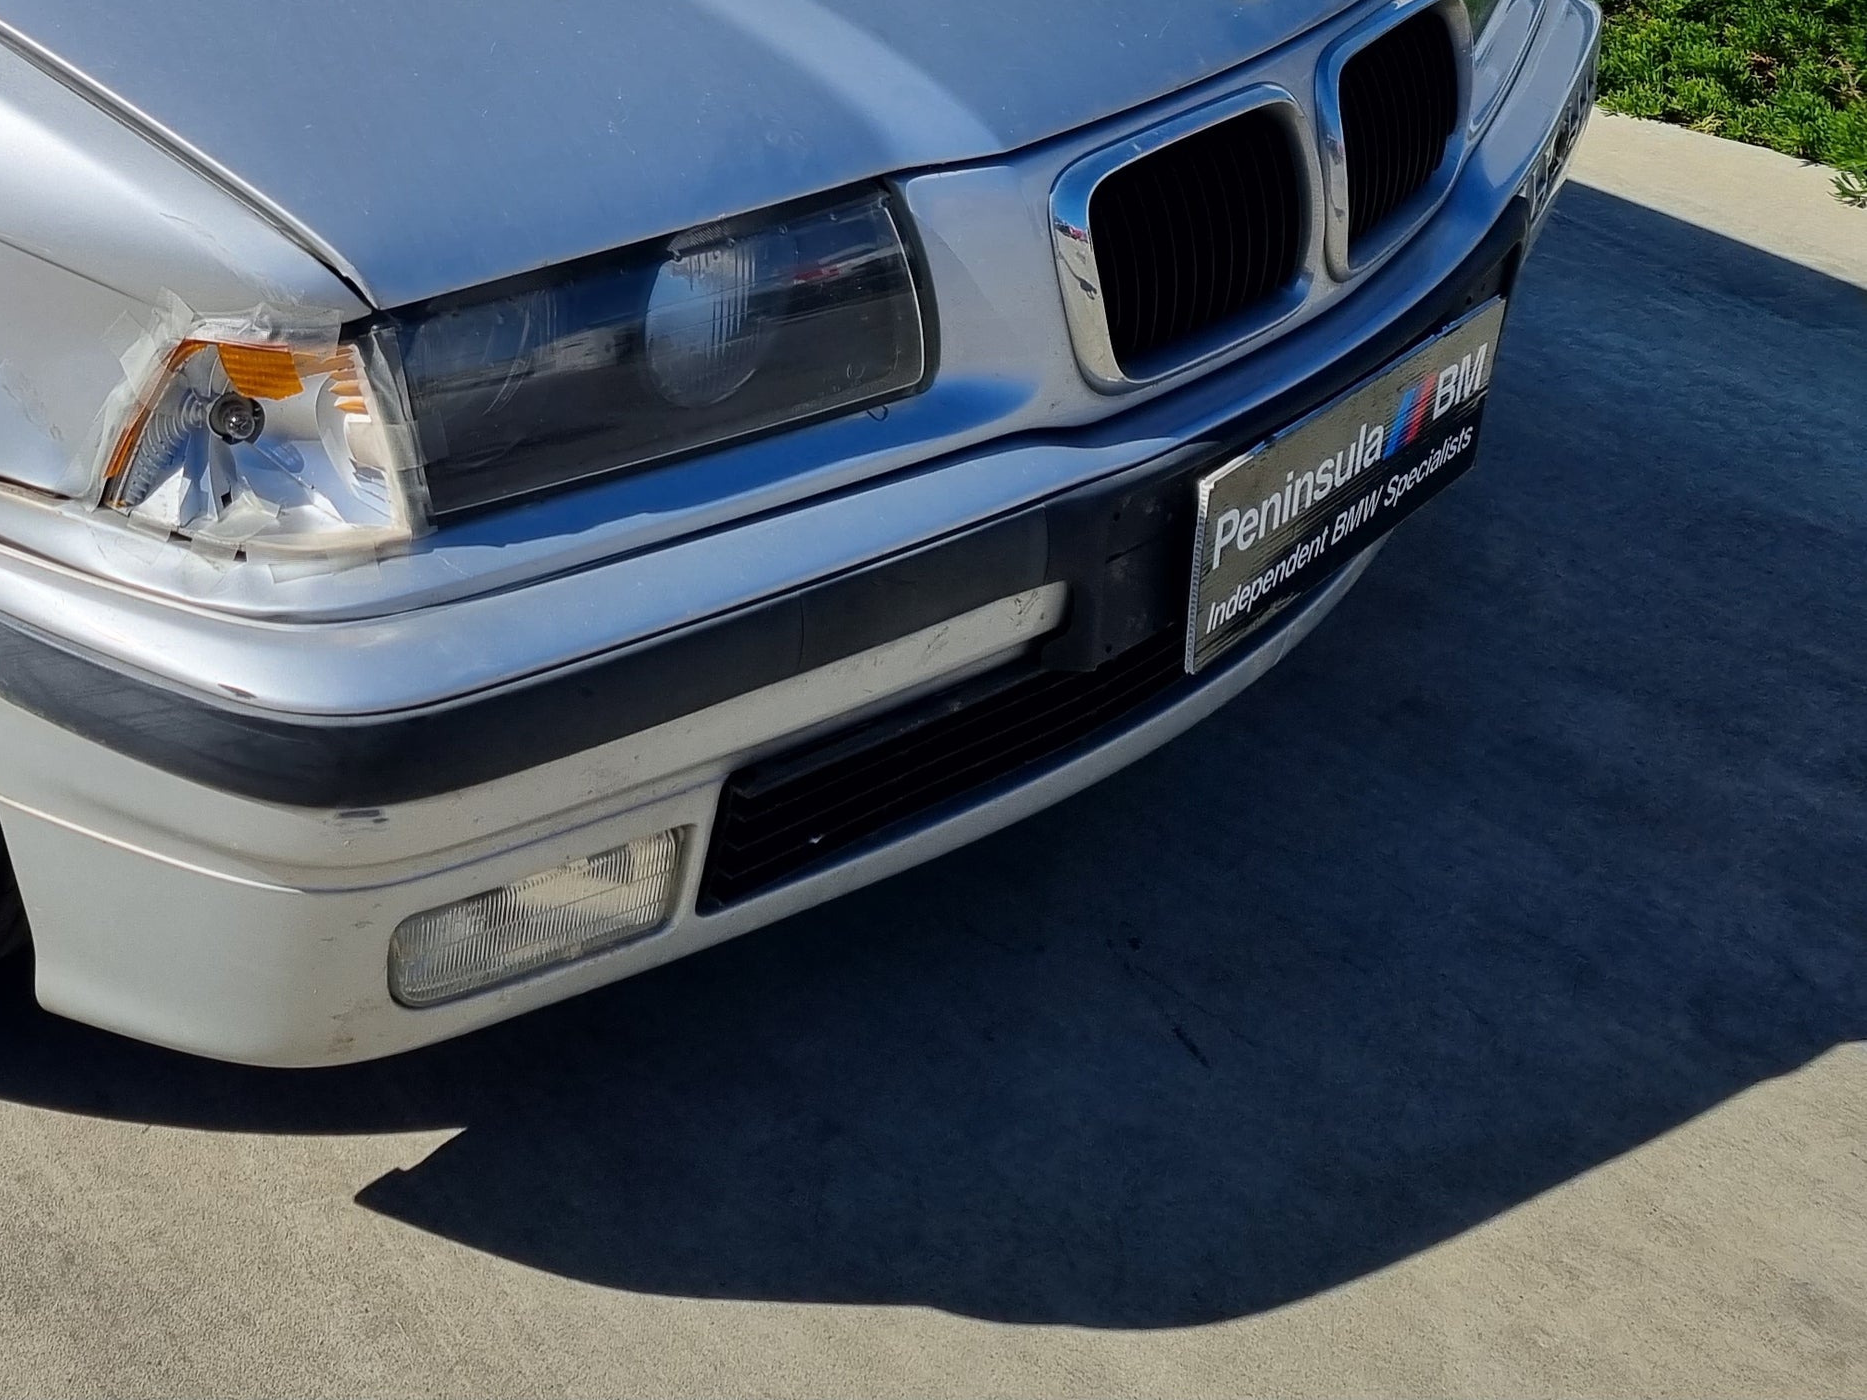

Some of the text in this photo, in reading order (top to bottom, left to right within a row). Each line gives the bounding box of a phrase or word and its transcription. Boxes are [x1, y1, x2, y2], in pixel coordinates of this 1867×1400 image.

[1206, 425, 1474, 634] Independent BMW Specialists
[1212, 343, 1489, 570] Peninsula BM
